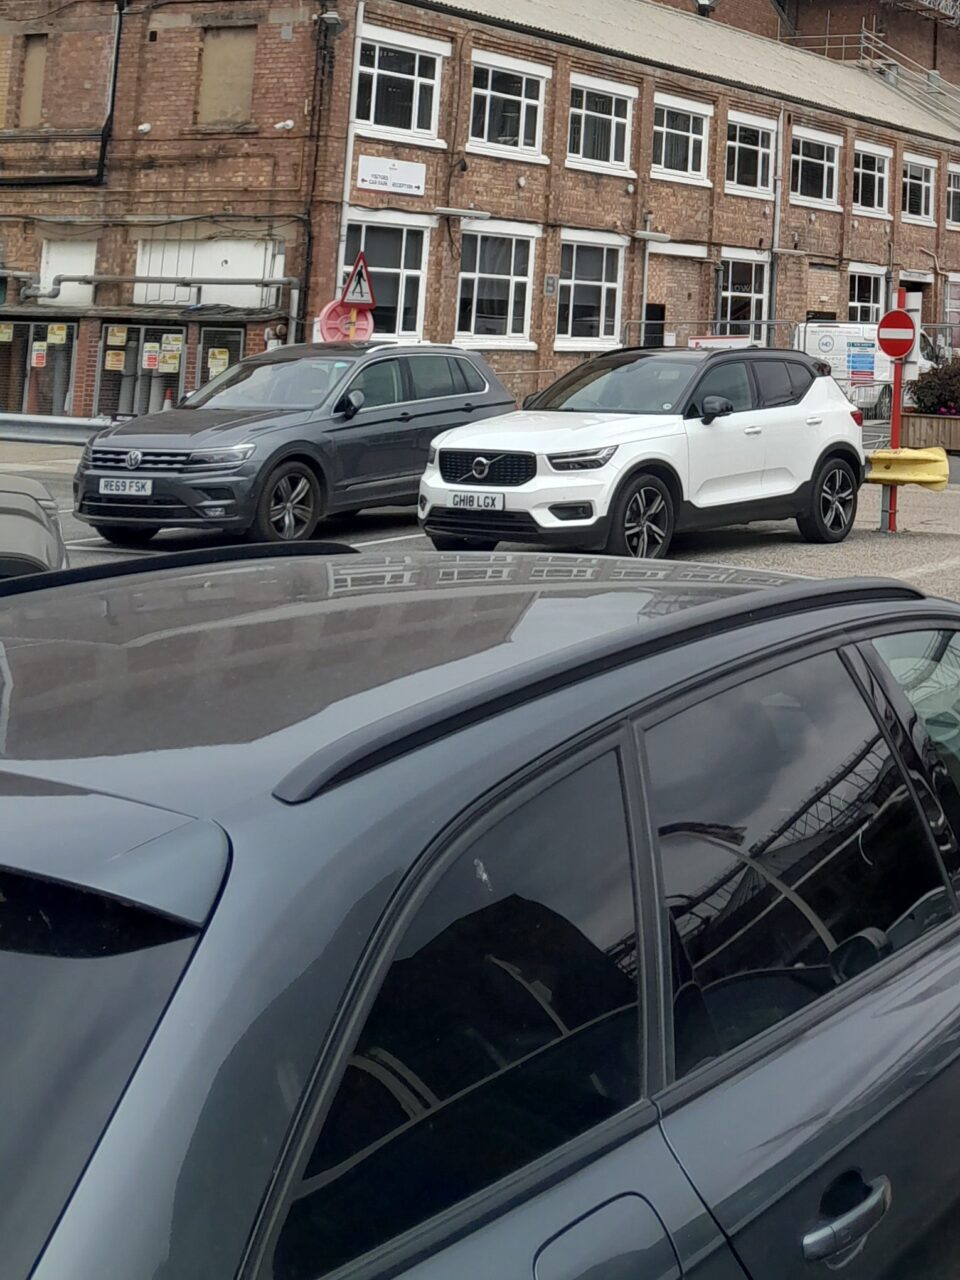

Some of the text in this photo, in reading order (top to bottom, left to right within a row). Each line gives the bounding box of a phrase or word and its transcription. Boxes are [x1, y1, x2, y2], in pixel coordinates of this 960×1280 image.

[104, 480, 148, 493] RE69 FSK
[453, 494, 497, 508] GH18 LGX
